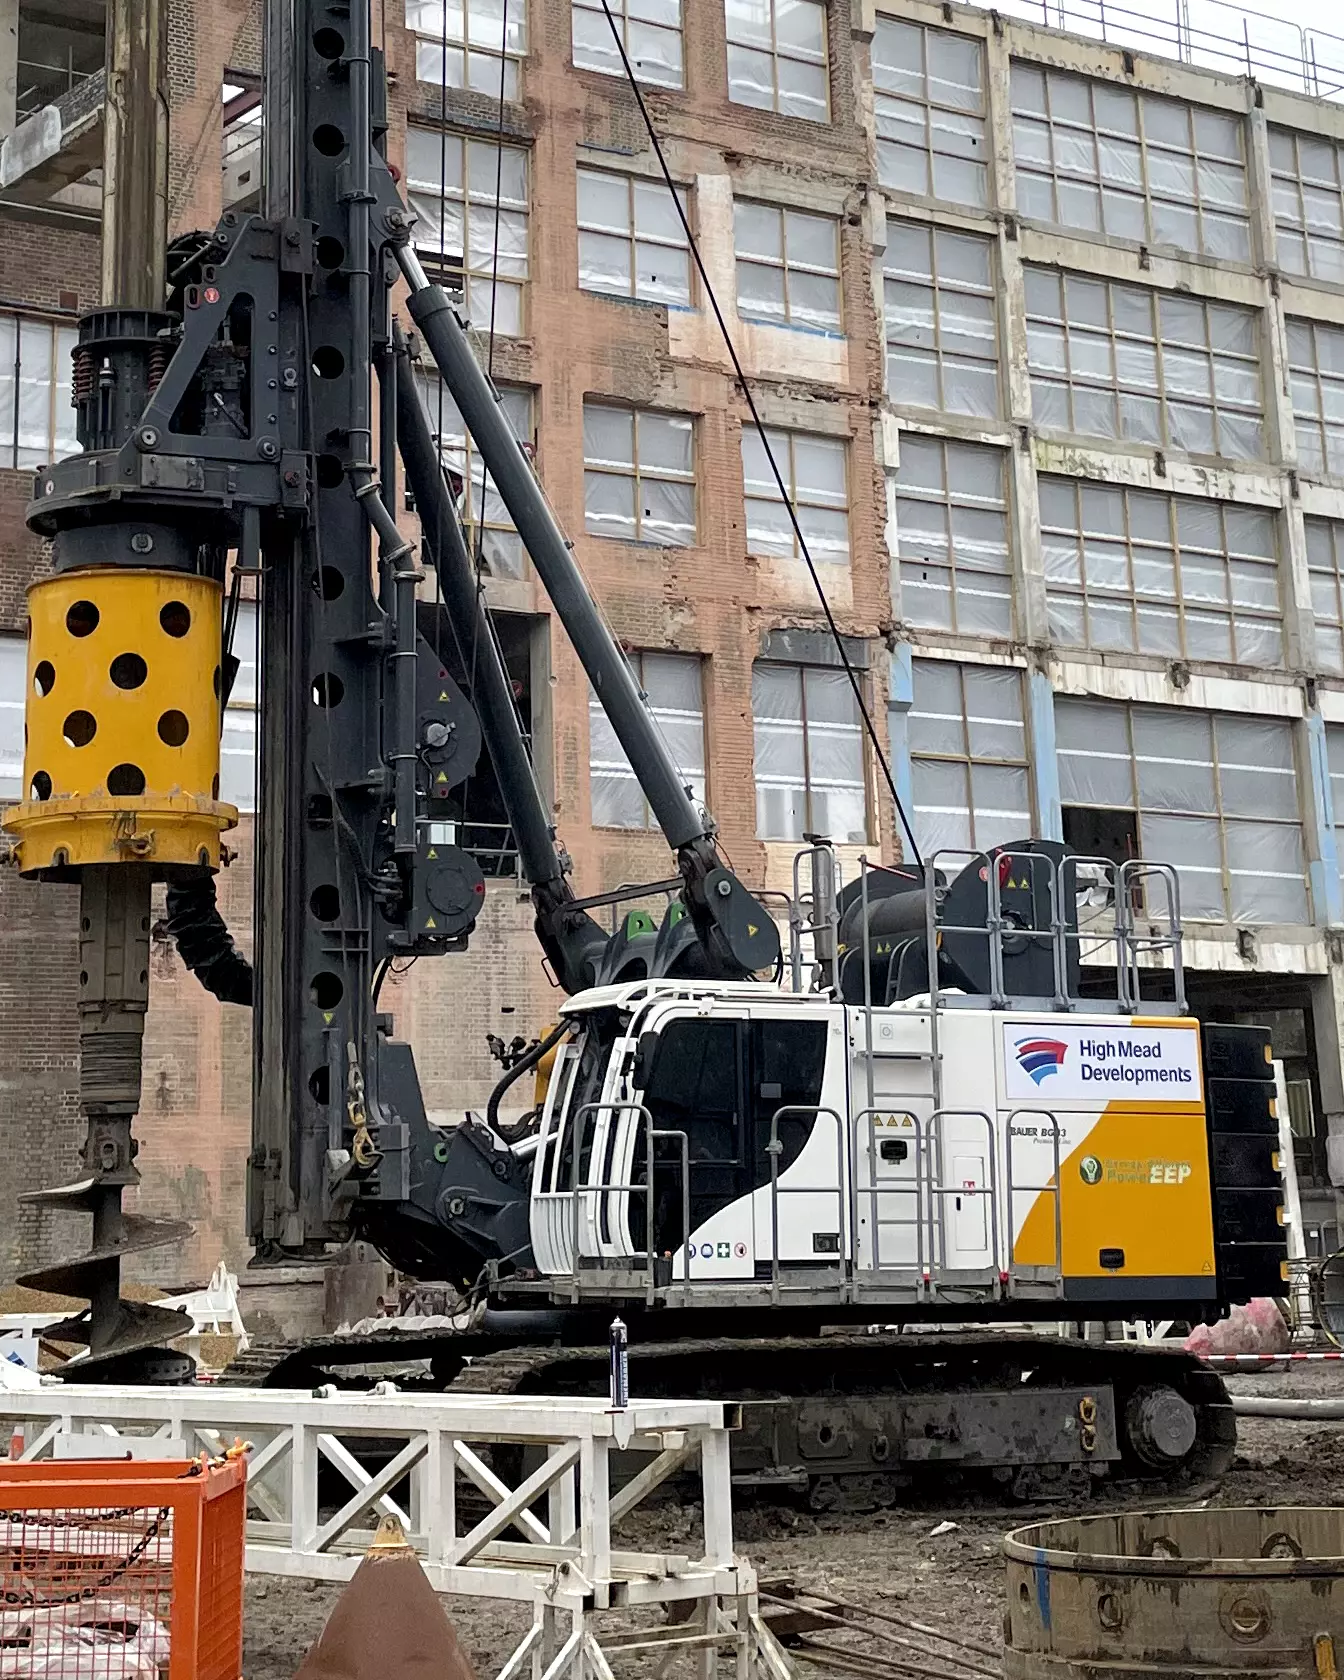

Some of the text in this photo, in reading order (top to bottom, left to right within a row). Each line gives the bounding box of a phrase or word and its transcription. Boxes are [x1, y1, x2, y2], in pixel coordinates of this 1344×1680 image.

[1079, 1040, 1162, 1061] High Mead
[1081, 1063, 1192, 1086] Developments
[1010, 1127, 1038, 1137] BAUER
[1149, 1164, 1192, 1184] EEP
